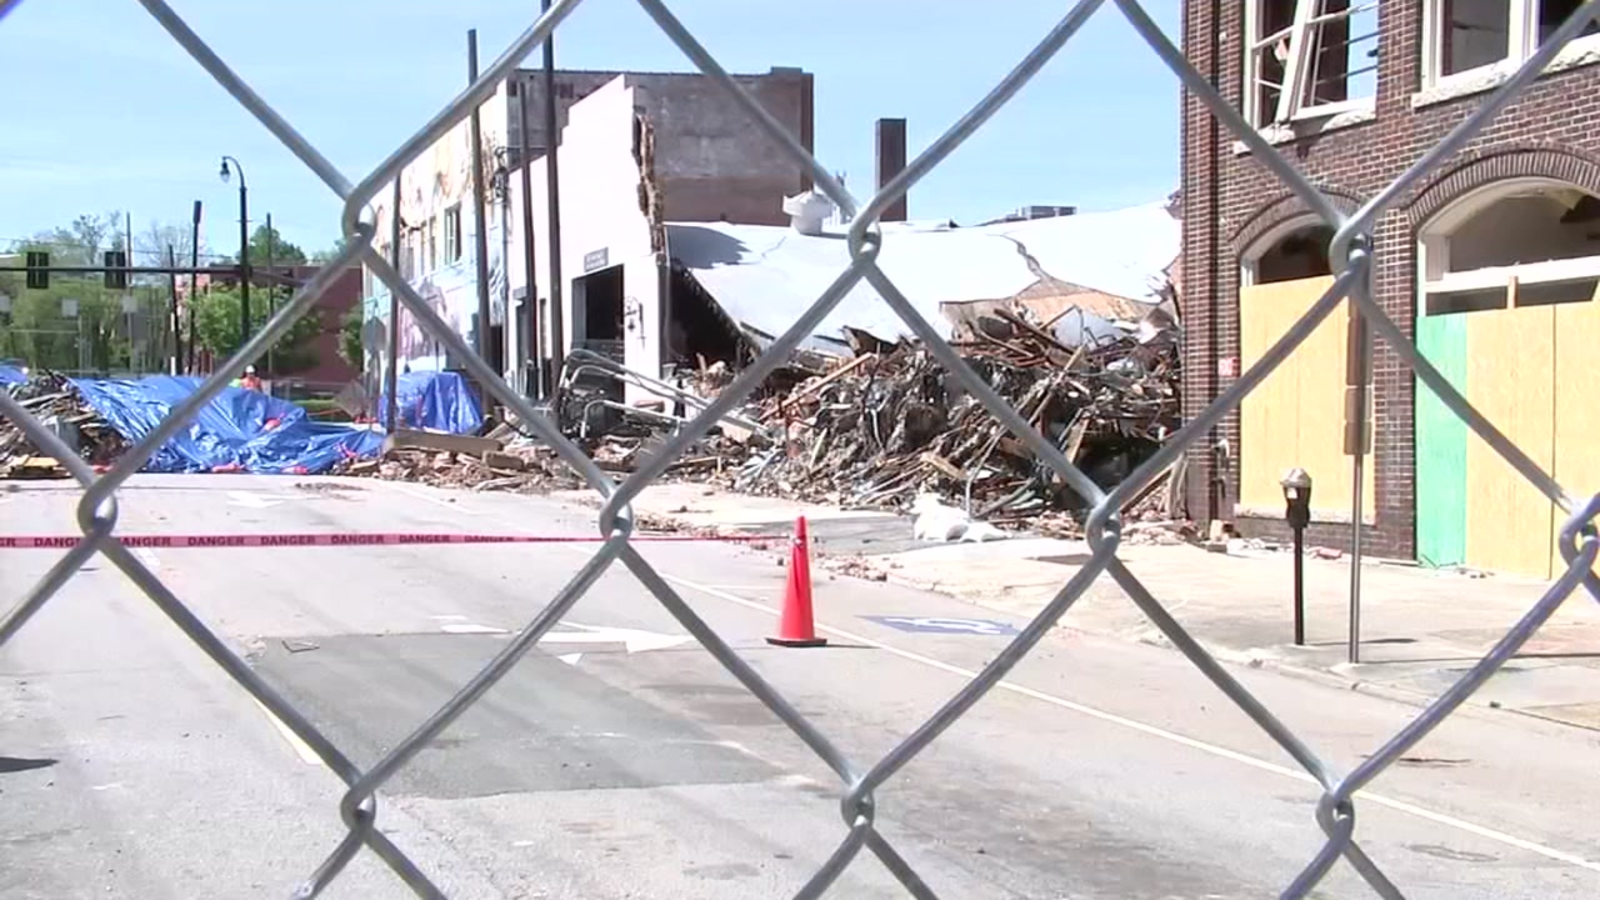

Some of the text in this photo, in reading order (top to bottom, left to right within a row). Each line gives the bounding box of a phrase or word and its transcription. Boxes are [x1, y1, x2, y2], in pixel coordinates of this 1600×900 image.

[35, 538, 80, 547] DANG
[121, 537, 171, 546] ANGER
[188, 536, 244, 546] DANGER
[261, 536, 315, 545] DANGER
[331, 535, 384, 544] DANGER
[400, 535, 450, 543] DANGER
